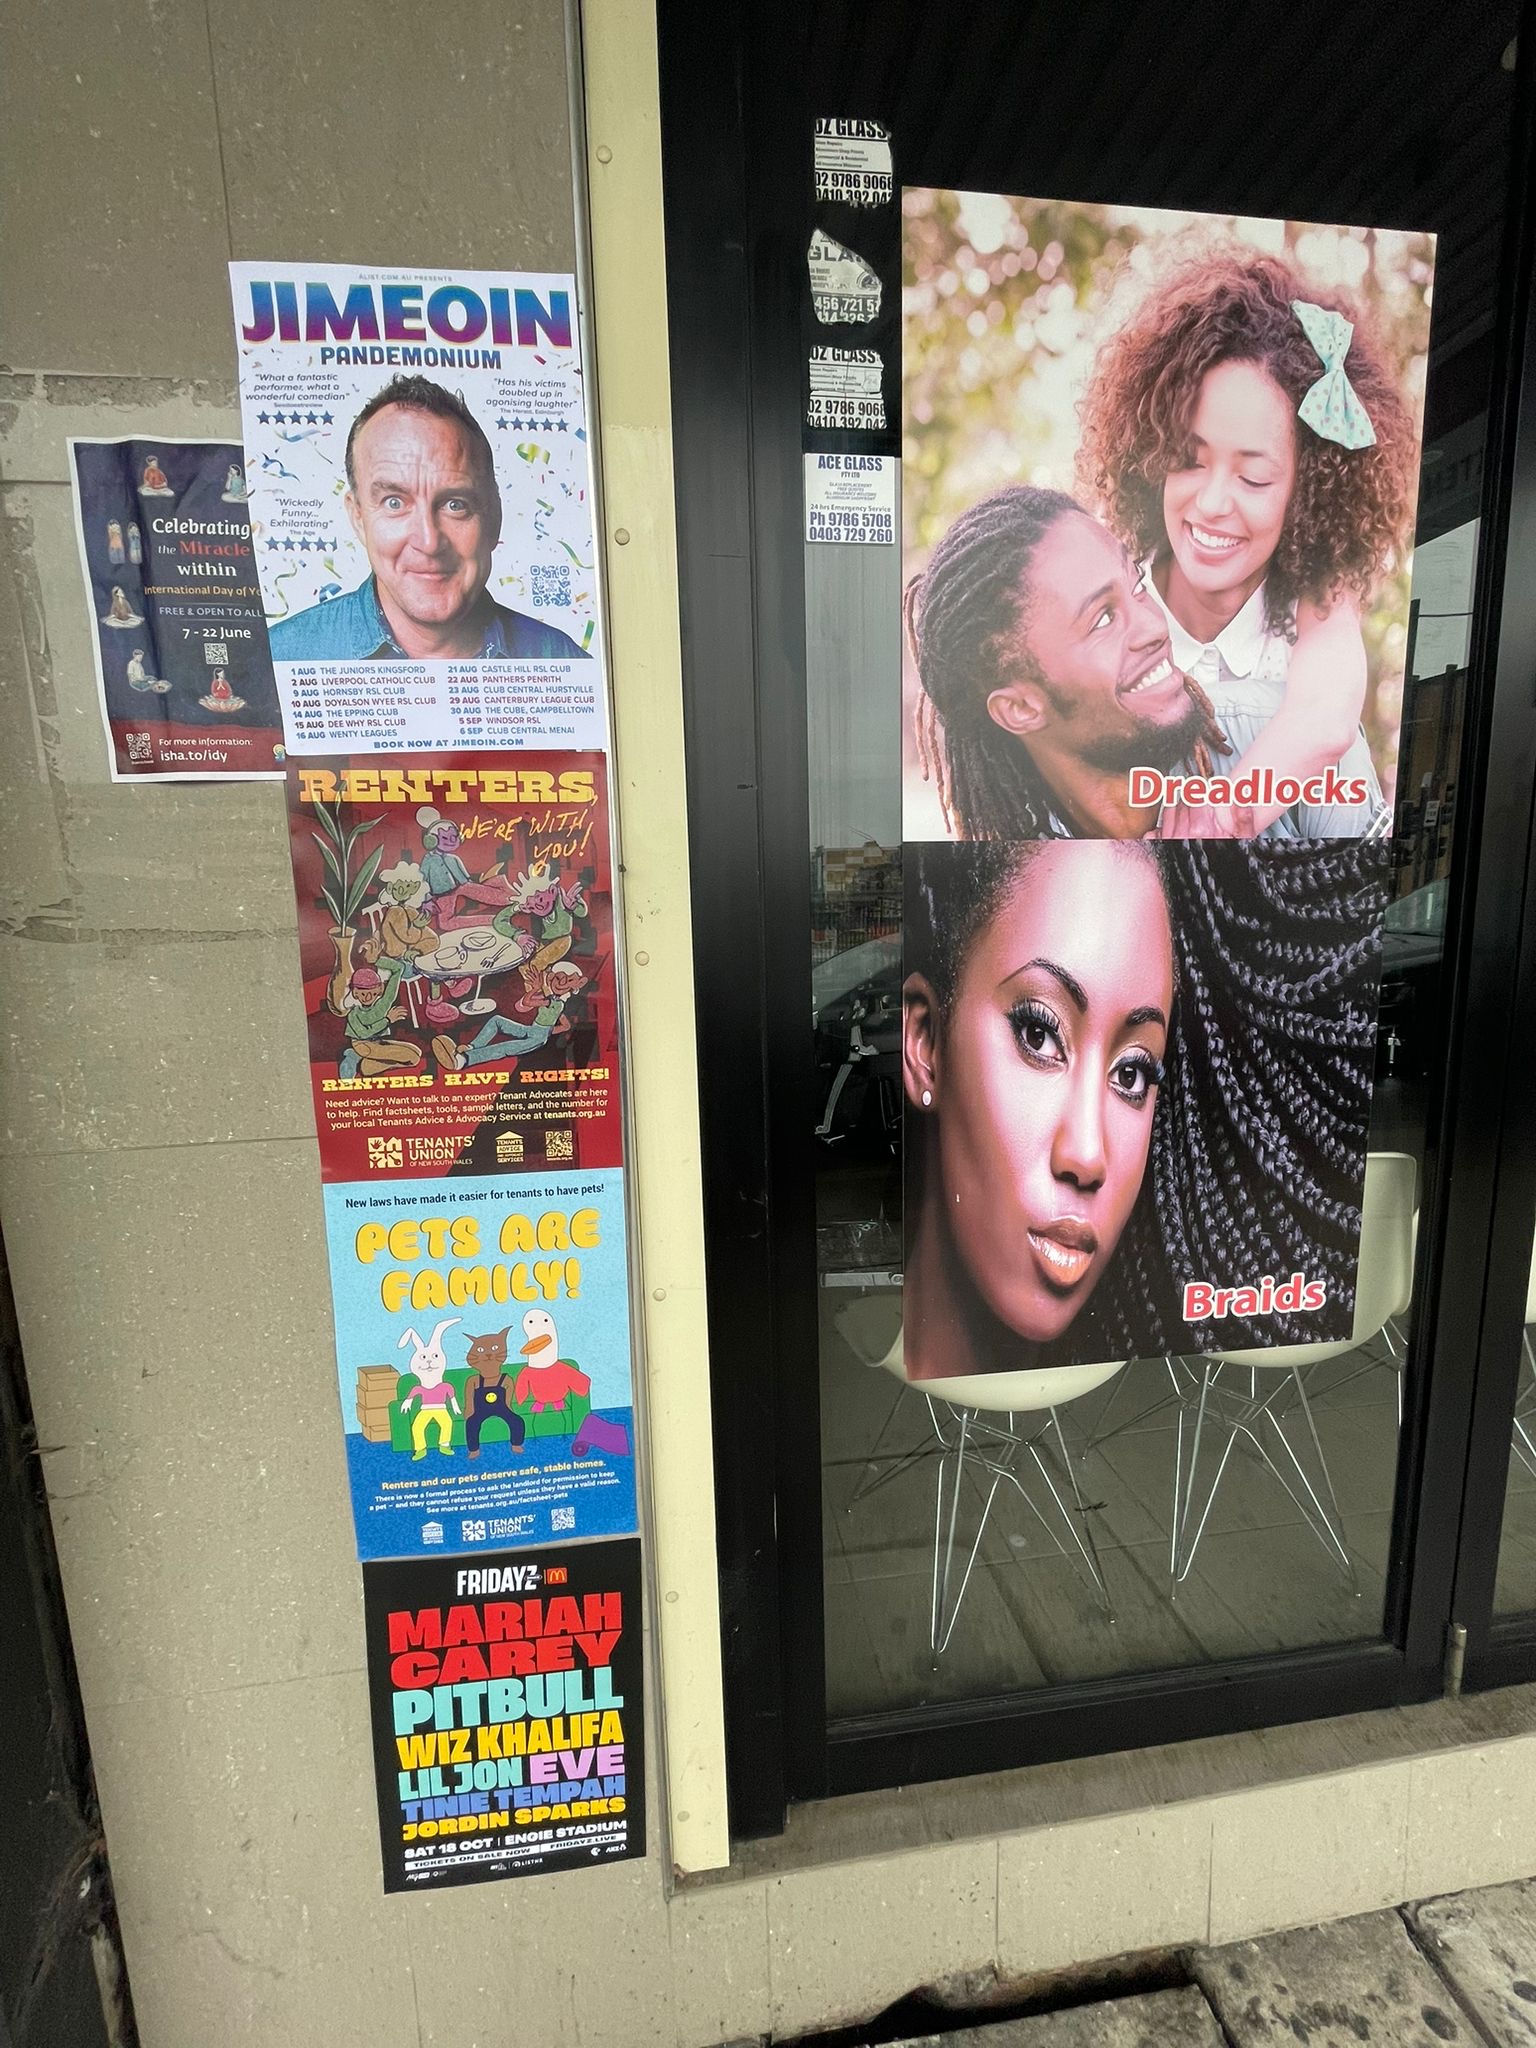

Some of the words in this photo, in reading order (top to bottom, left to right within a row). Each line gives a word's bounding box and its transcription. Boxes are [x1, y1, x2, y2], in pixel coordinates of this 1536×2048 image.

[835, 119, 887, 139] GLASS
[831, 173, 861, 188] 9786
[242, 280, 572, 348] JIMEOIN
[320, 346, 501, 370] PANDEMONIUM
[832, 348, 876, 364] GLASS
[255, 373, 285, 381] "What
[296, 373, 339, 382] fantastic
[494, 378, 516, 386] "Has
[519, 379, 533, 387] his
[534, 380, 567, 388] victims
[253, 384, 304, 392] performer,
[499, 388, 538, 397] doubled
[540, 391, 553, 399] up
[554, 390, 563, 398] in
[245, 393, 295, 401] wonderful
[299, 392, 351, 401] comedian"
[486, 398, 532, 408] agonising
[535, 399, 578, 409] laughter"
[825, 400, 855, 415] 9786
[818, 455, 841, 469] ACE
[844, 456, 883, 471] GLASS
[275, 498, 324, 508] "Wickedly
[831, 504, 867, 512] Emergency
[270, 519, 334, 529] Exhilarating"
[810, 512, 825, 526] Ph
[828, 512, 859, 527] 9786
[862, 513, 892, 527] 5708
[152, 518, 251, 540] Celebrating
[809, 526, 841, 541] 0403
[844, 527, 866, 542] 729
[869, 529, 893, 542] 260
[158, 545, 176, 555] the
[179, 540, 251, 556] Miracle
[177, 562, 237, 576] within
[144, 585, 211, 595] International
[213, 586, 233, 597] Day
[236, 586, 246, 597] of
[159, 606, 185, 616] FREE
[187, 607, 194, 616] &
[196, 607, 225, 616] OPEN
[227, 608, 242, 617] TO
[244, 609, 263, 618] ALL
[182, 629, 190, 639] 7
[203, 628, 217, 638] 22
[220, 627, 251, 639] June
[459, 665, 477, 673] AUG
[482, 665, 511, 673] CASTLE
[198, 738, 253, 747] information:
[452, 738, 524, 746] JIMEOIN.COM
[161, 750, 228, 763] isha.to/idy
[1129, 767, 1369, 807] Dreadlocks
[458, 814, 523, 841] WE'RE
[529, 808, 590, 838] WITH
[533, 821, 594, 875] YOU!
[322, 1074, 434, 1091] RENTERS
[444, 1071, 510, 1086] HAVE
[520, 1068, 610, 1083] RIGHTS!
[325, 1100, 349, 1108] Need
[351, 1097, 385, 1106] advice?
[386, 1096, 410, 1105] Want
[411, 1096, 421, 1104] to
[423, 1095, 439, 1103] talk
[440, 1095, 450, 1103] to
[464, 1092, 496, 1102] expert?
[499, 1091, 527, 1100] Tenant
[529, 1089, 572, 1099] Advocates
[589, 1088, 608, 1097] here
[409, 1149, 454, 1160] UNION
[345, 1198, 367, 1209] New
[369, 1197, 392, 1207] laws
[394, 1196, 418, 1206] have
[420, 1194, 447, 1204] made
[449, 1192, 457, 1202] it
[459, 1191, 488, 1202] easier
[490, 1190, 504, 1200] for
[506, 1188, 542, 1199] tenants
[544, 1187, 555, 1197] to
[556, 1186, 579, 1196] have
[581, 1184, 605, 1196] pets!
[355, 1215, 482, 1264] PETS
[499, 1207, 602, 1255] ARE
[380, 1257, 582, 1313] FAMILY!
[1183, 1273, 1326, 1320] Braids
[381, 1480, 419, 1490] Renters
[421, 1478, 439, 1486] and
[440, 1477, 457, 1485] our
[458, 1474, 479, 1484] pets
[480, 1470, 518, 1480] deserve
[519, 1466, 542, 1475] safe,
[543, 1462, 572, 1473] stable
[573, 1460, 606, 1470] homes.
[490, 1524, 521, 1536] UNION
[457, 1565, 540, 1596] FRIDAYZ
[388, 1591, 623, 1654] MARIAH
[391, 1630, 623, 1689] CAREY
[392, 1666, 624, 1736] PITBULL
[395, 1728, 472, 1770] WIZ
[477, 1711, 625, 1759] KHALIFA
[398, 1766, 450, 1800] LIL
[454, 1756, 523, 1793] JON
[529, 1744, 625, 1785] EVE
[401, 1791, 490, 1823] TINIE
[493, 1774, 626, 1810] TEMPAH
[402, 1811, 509, 1840] JORDIN
[514, 1796, 626, 1825] SPARKS
[404, 1845, 436, 1859] SAT
[438, 1843, 457, 1853] 18
[460, 1837, 494, 1851] OCT
[505, 1829, 553, 1846] ENGIE
[555, 1820, 627, 1838] STADIUM
[413, 1858, 456, 1867] TICKETS
[505, 1848, 530, 1856] NOW
[550, 1835, 617, 1849] FRIDAYZ.LIVE
